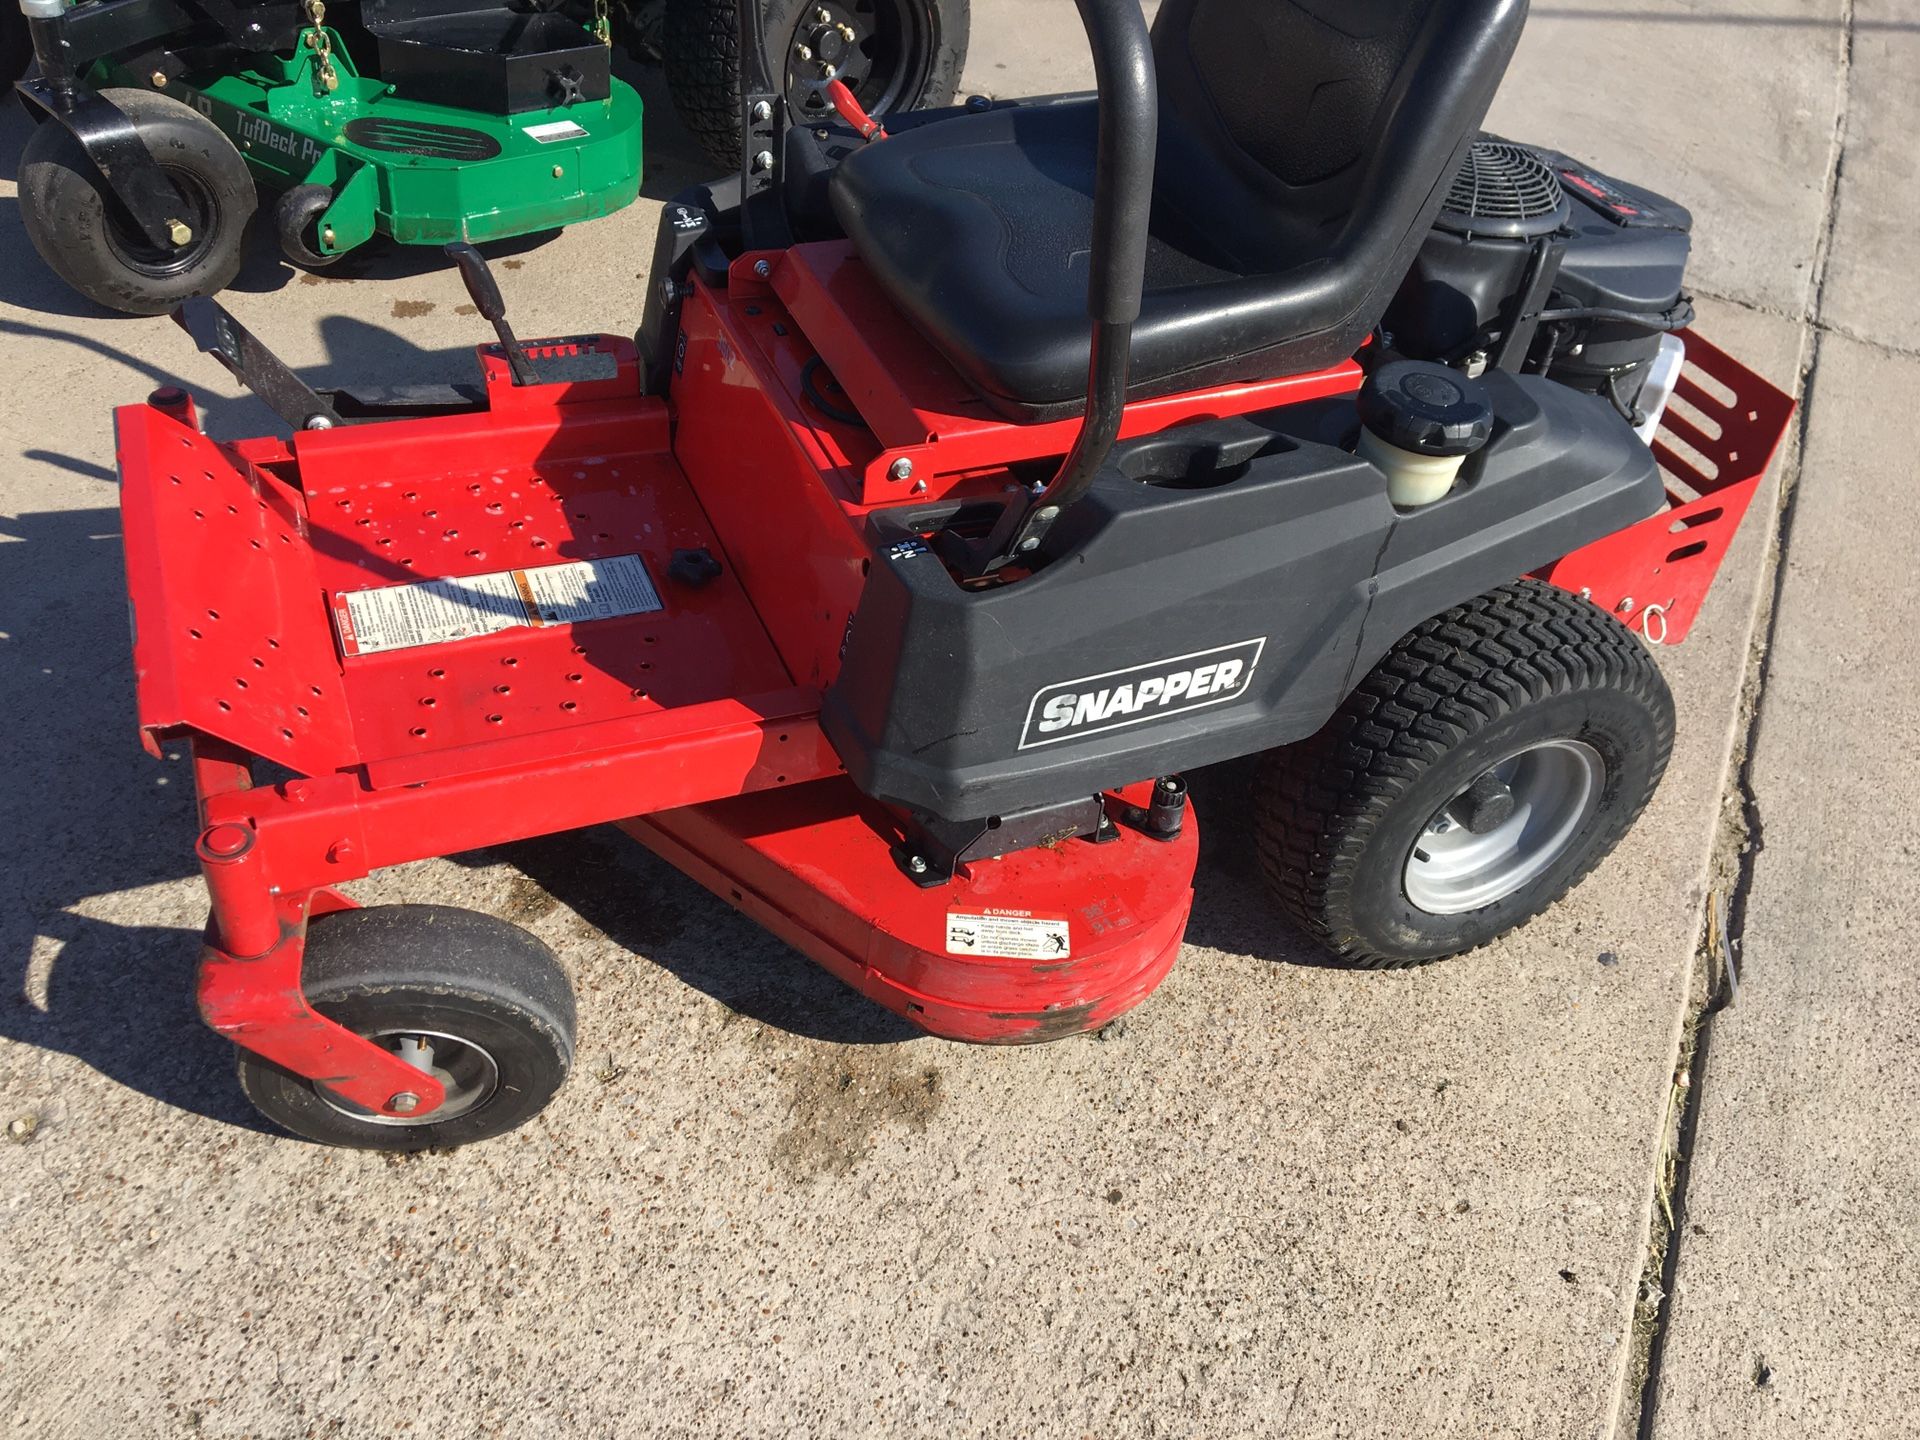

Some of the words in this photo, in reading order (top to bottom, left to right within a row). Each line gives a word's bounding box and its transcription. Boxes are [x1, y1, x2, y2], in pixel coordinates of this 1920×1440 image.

[235, 110, 297, 157] TufDeck
[338, 608, 351, 633] DANGER
[1039, 659, 1243, 732] SNAPPER
[993, 909, 1031, 917] DANGER
